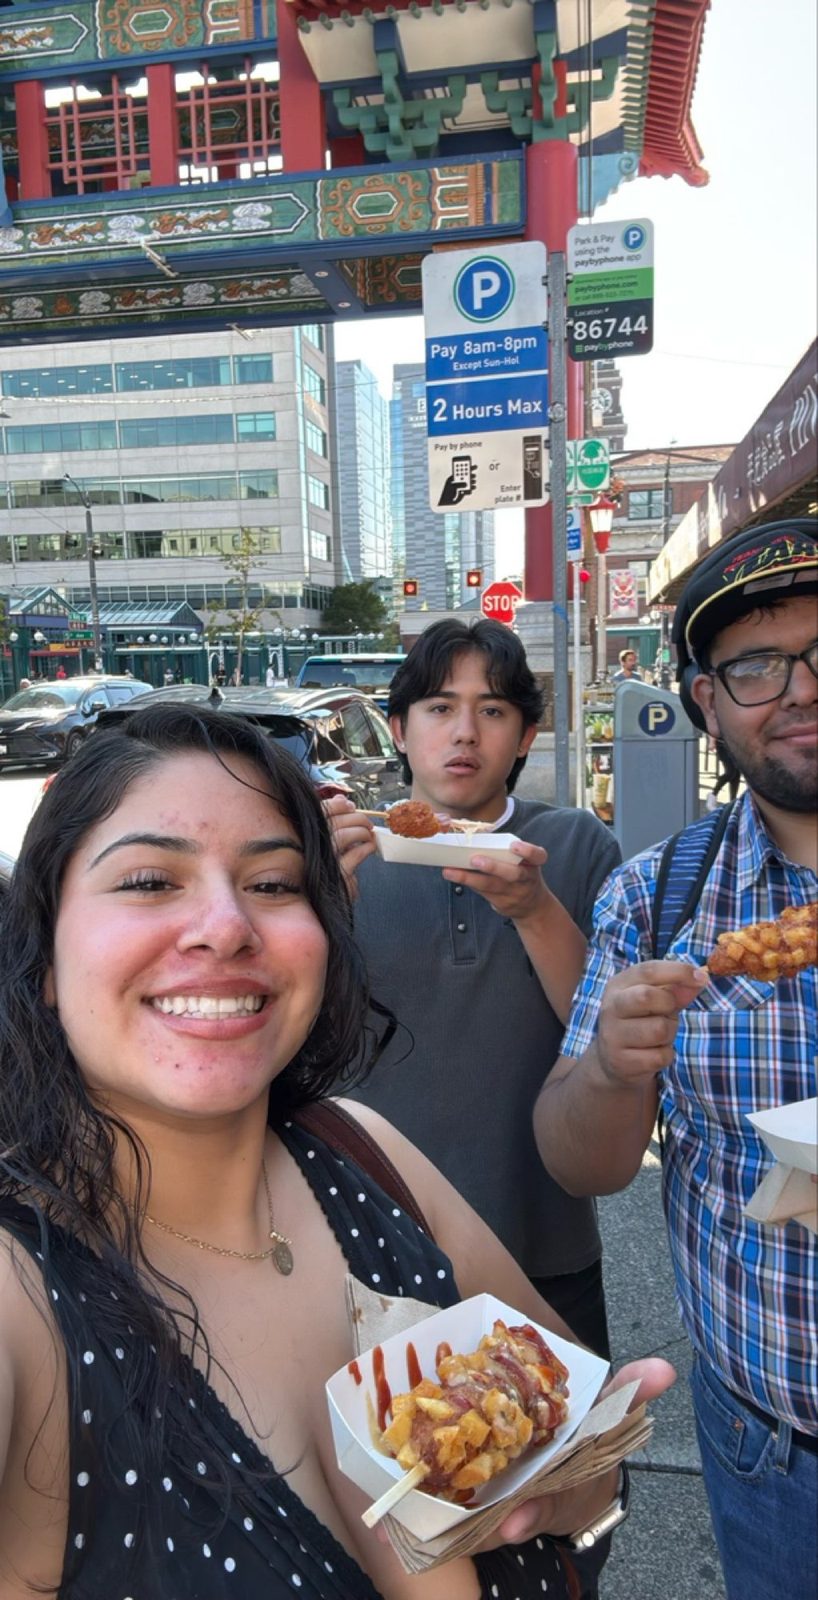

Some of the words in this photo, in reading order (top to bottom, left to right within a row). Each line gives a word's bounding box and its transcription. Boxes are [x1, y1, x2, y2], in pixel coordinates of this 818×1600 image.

[574, 236, 591, 246] Park
[593, 235, 599, 243] &
[600, 233, 616, 243] Pay
[629, 230, 642, 246] P
[574, 248, 595, 256] using
[574, 256, 624, 268] paybyphone
[473, 270, 501, 310] P
[575, 281, 638, 293] paybyphone.com
[575, 309, 604, 317] Location
[573, 315, 648, 341] 86744
[431, 344, 458, 360] Pay
[464, 336, 537, 355] 8am-8pm
[584, 341, 634, 352] paybyphone
[453, 360, 482, 371] Except
[483, 356, 520, 368] Sun-Hol
[433, 398, 448, 422] 2
[453, 404, 503, 420] Hours
[508, 398, 542, 416] Max
[434, 443, 448, 451] Pay
[449, 442, 459, 451] by
[460, 441, 483, 450] phone
[489, 463, 501, 471] or
[500, 485, 521, 493] Enter
[494, 495, 514, 504] plate
[483, 595, 520, 611] STOP
[648, 704, 668, 731] P
